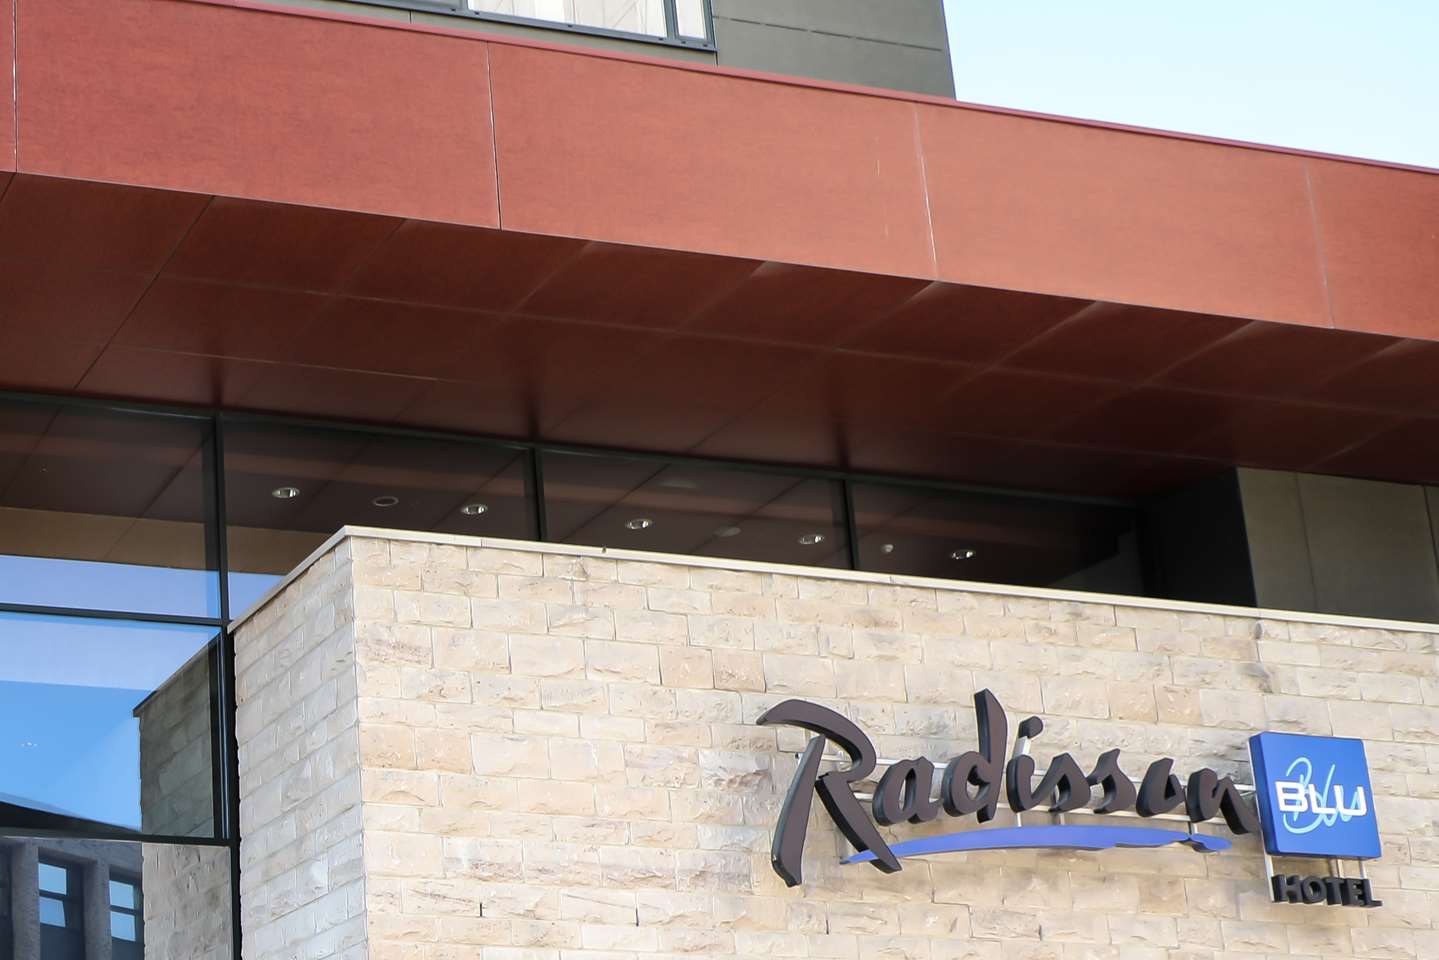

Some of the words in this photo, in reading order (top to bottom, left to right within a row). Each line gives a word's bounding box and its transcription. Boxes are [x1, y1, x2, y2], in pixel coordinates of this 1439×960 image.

[756, 688, 1259, 888] Radisson
[1275, 781, 1367, 816] BLU
[1271, 874, 1383, 907] HOTEL
